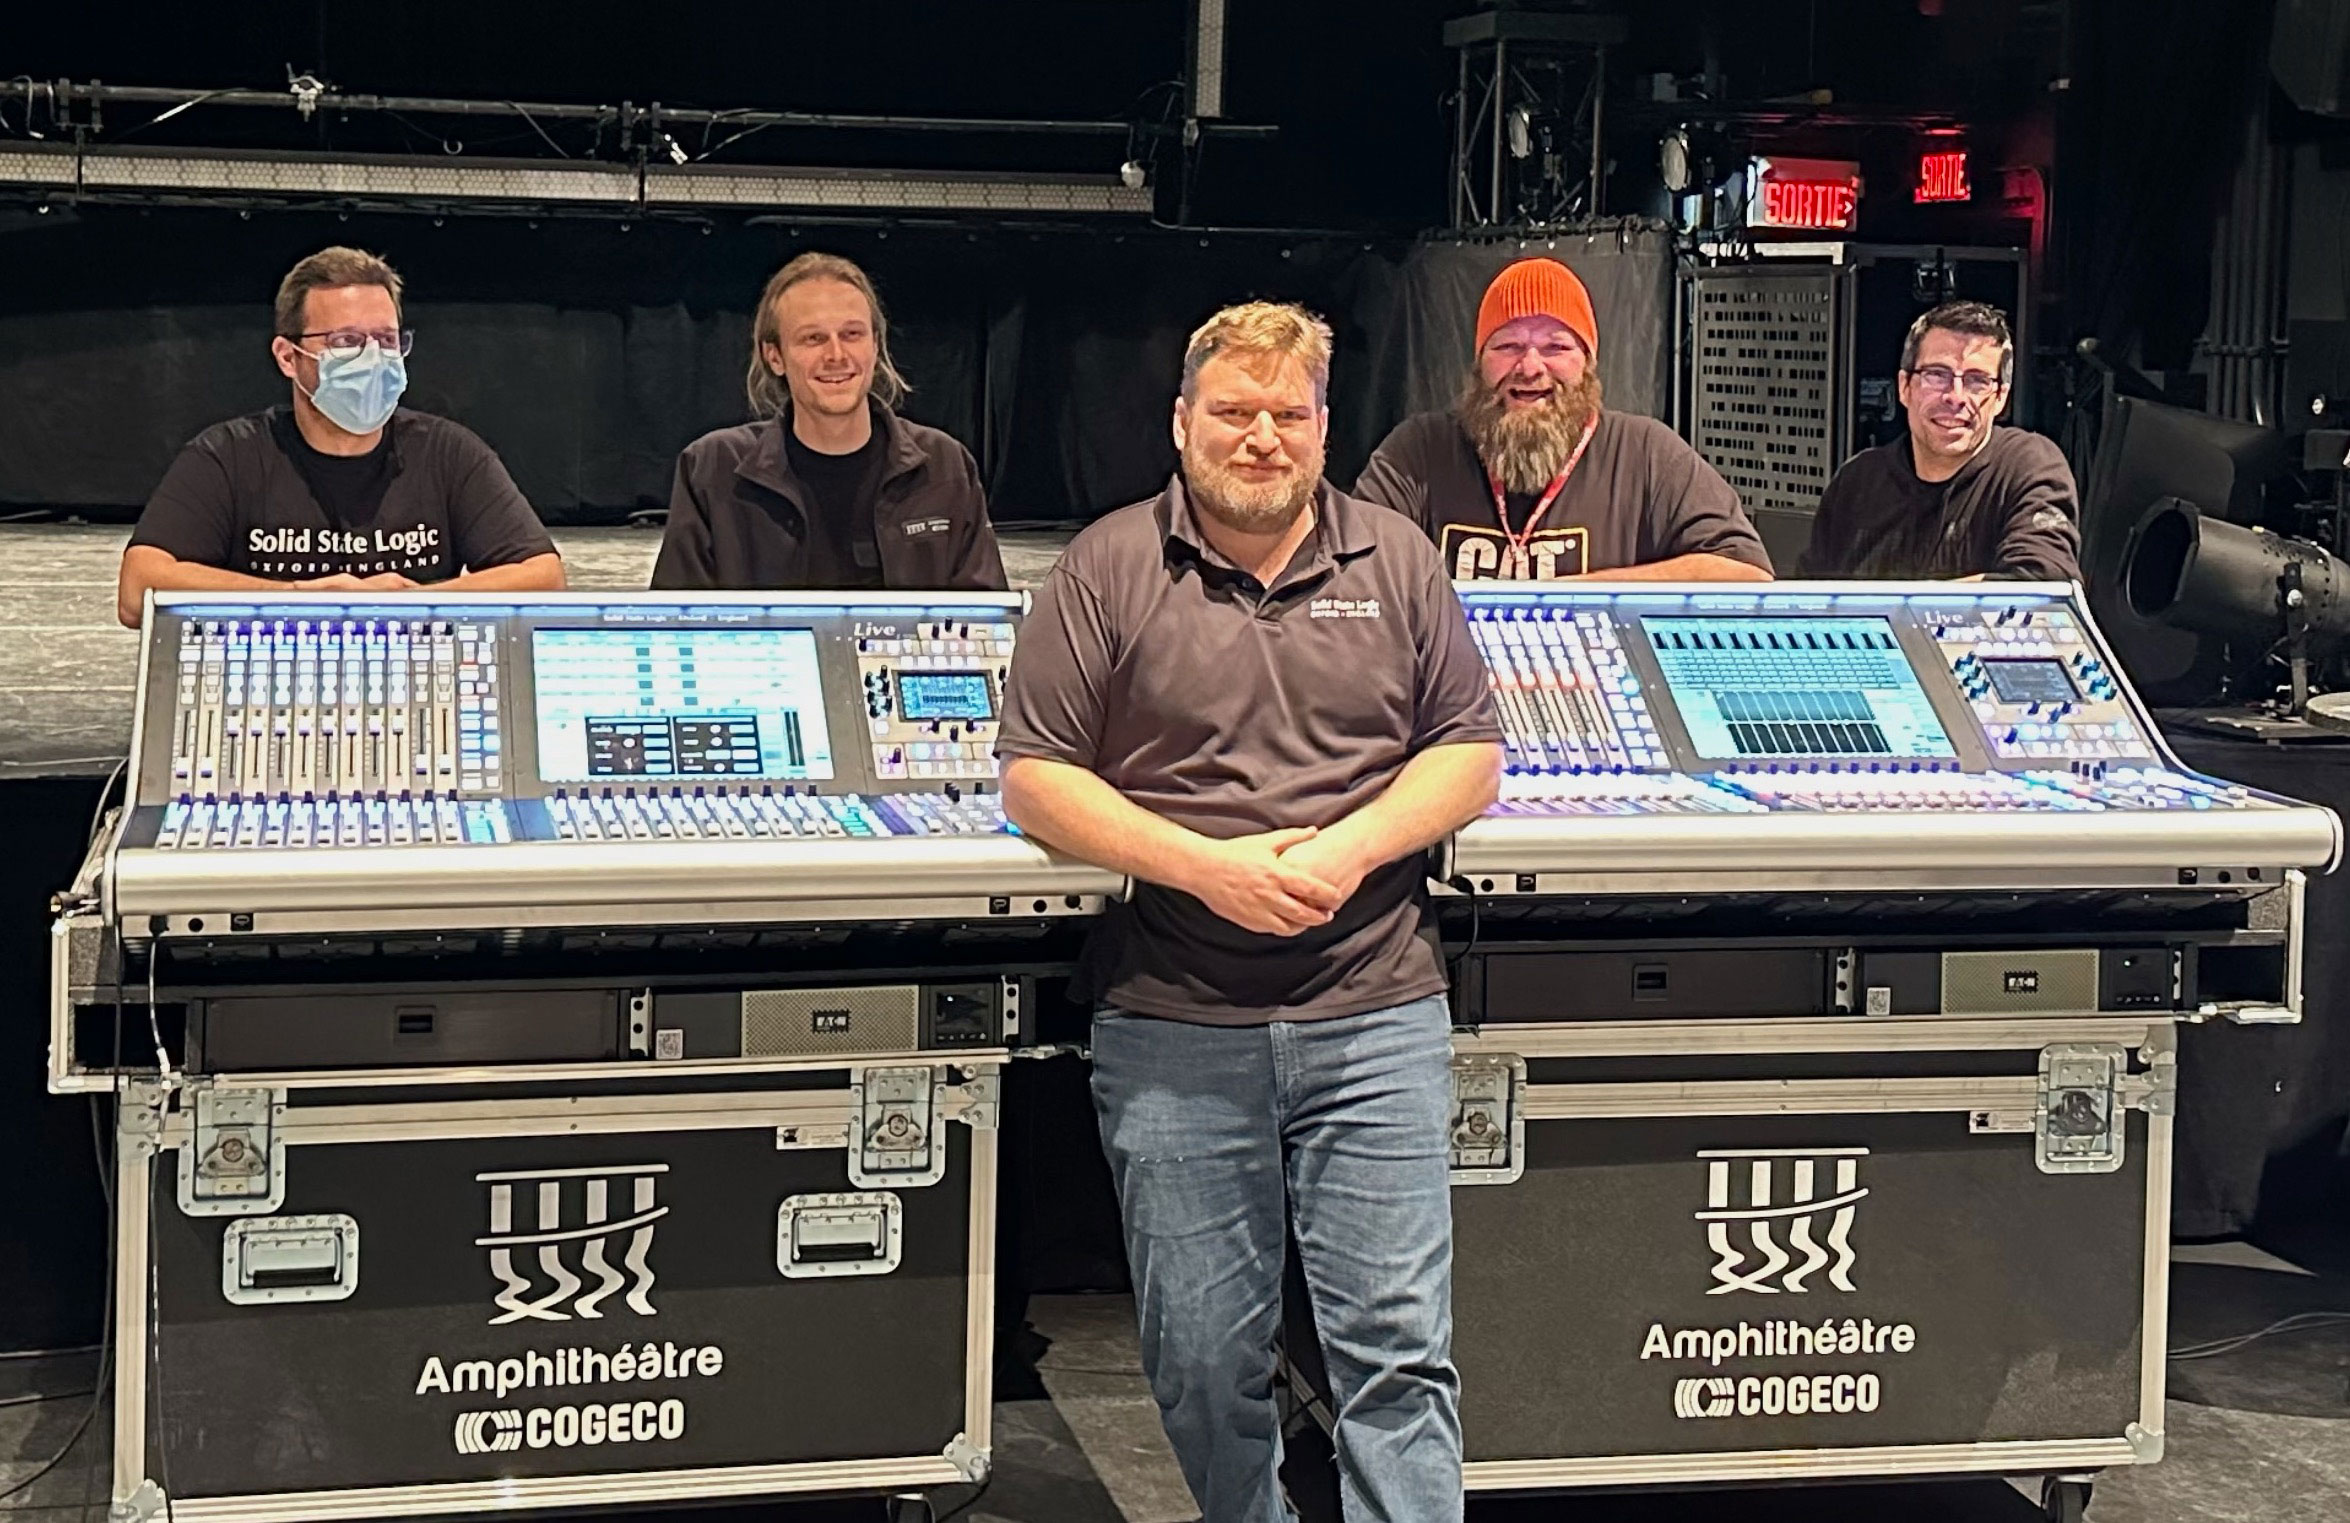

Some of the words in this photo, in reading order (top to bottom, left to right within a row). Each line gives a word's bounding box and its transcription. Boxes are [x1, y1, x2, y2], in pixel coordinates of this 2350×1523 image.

[1921, 154, 1966, 198] SORTIE
[1765, 182, 1847, 227] SORTIE
[249, 528, 311, 553] Solid
[375, 523, 439, 556] Logic
[853, 621, 896, 637] Live
[1924, 609, 1964, 624] Live
[1640, 1318, 1916, 1367] Amphithéâtre
[415, 1341, 724, 1398] Amphithéâtre
[1737, 1373, 1880, 1416] COGECO
[526, 1398, 685, 1449] COGECO
